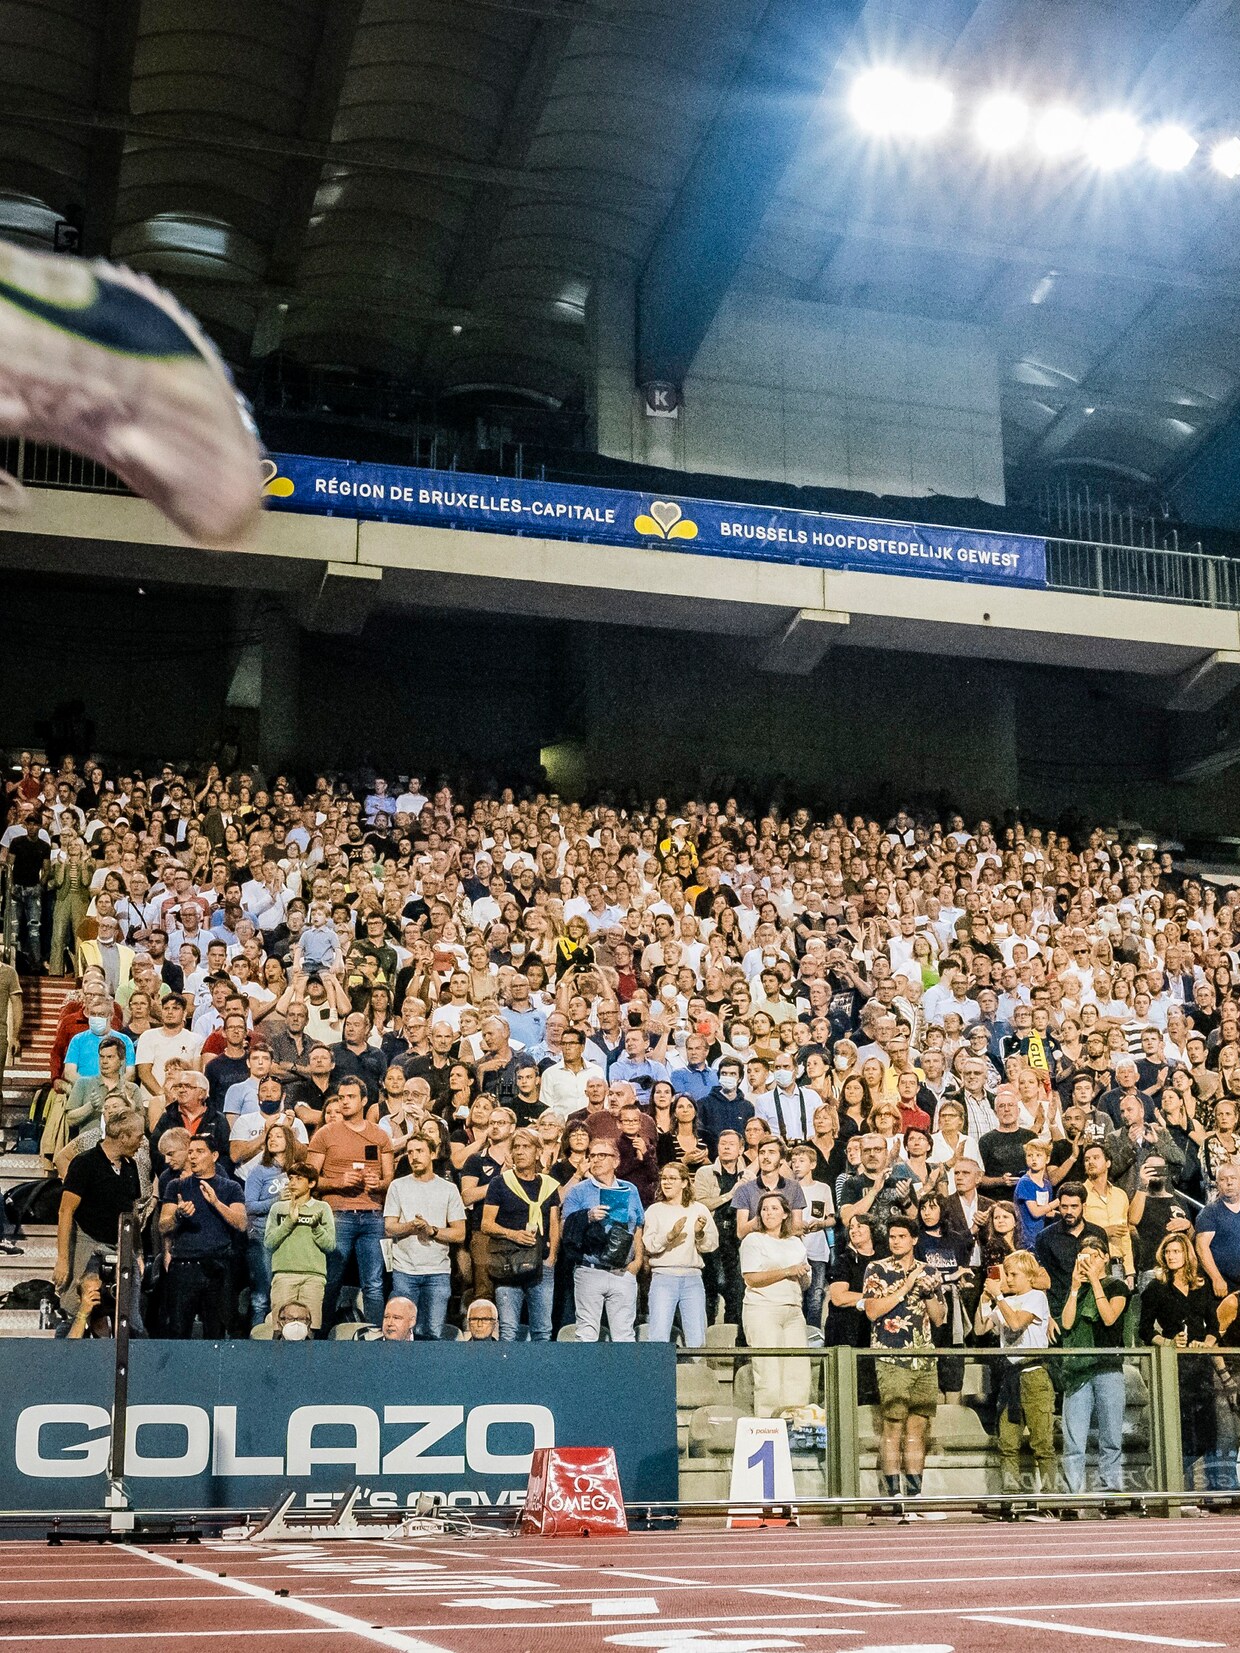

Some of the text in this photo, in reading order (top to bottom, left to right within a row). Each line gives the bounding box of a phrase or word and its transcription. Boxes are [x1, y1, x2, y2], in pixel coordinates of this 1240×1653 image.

[655, 390, 669, 406] K
[316, 476, 615, 523] RÉGION DE BRUXELLES-CAPITALE
[720, 522, 1020, 567] BRUSSELS HOOFDSTEDELIJK GEWEST
[14, 1402, 557, 1478] GOLAZO
[747, 1440, 775, 1500] 1
[548, 1494, 621, 1512] OMEGA
